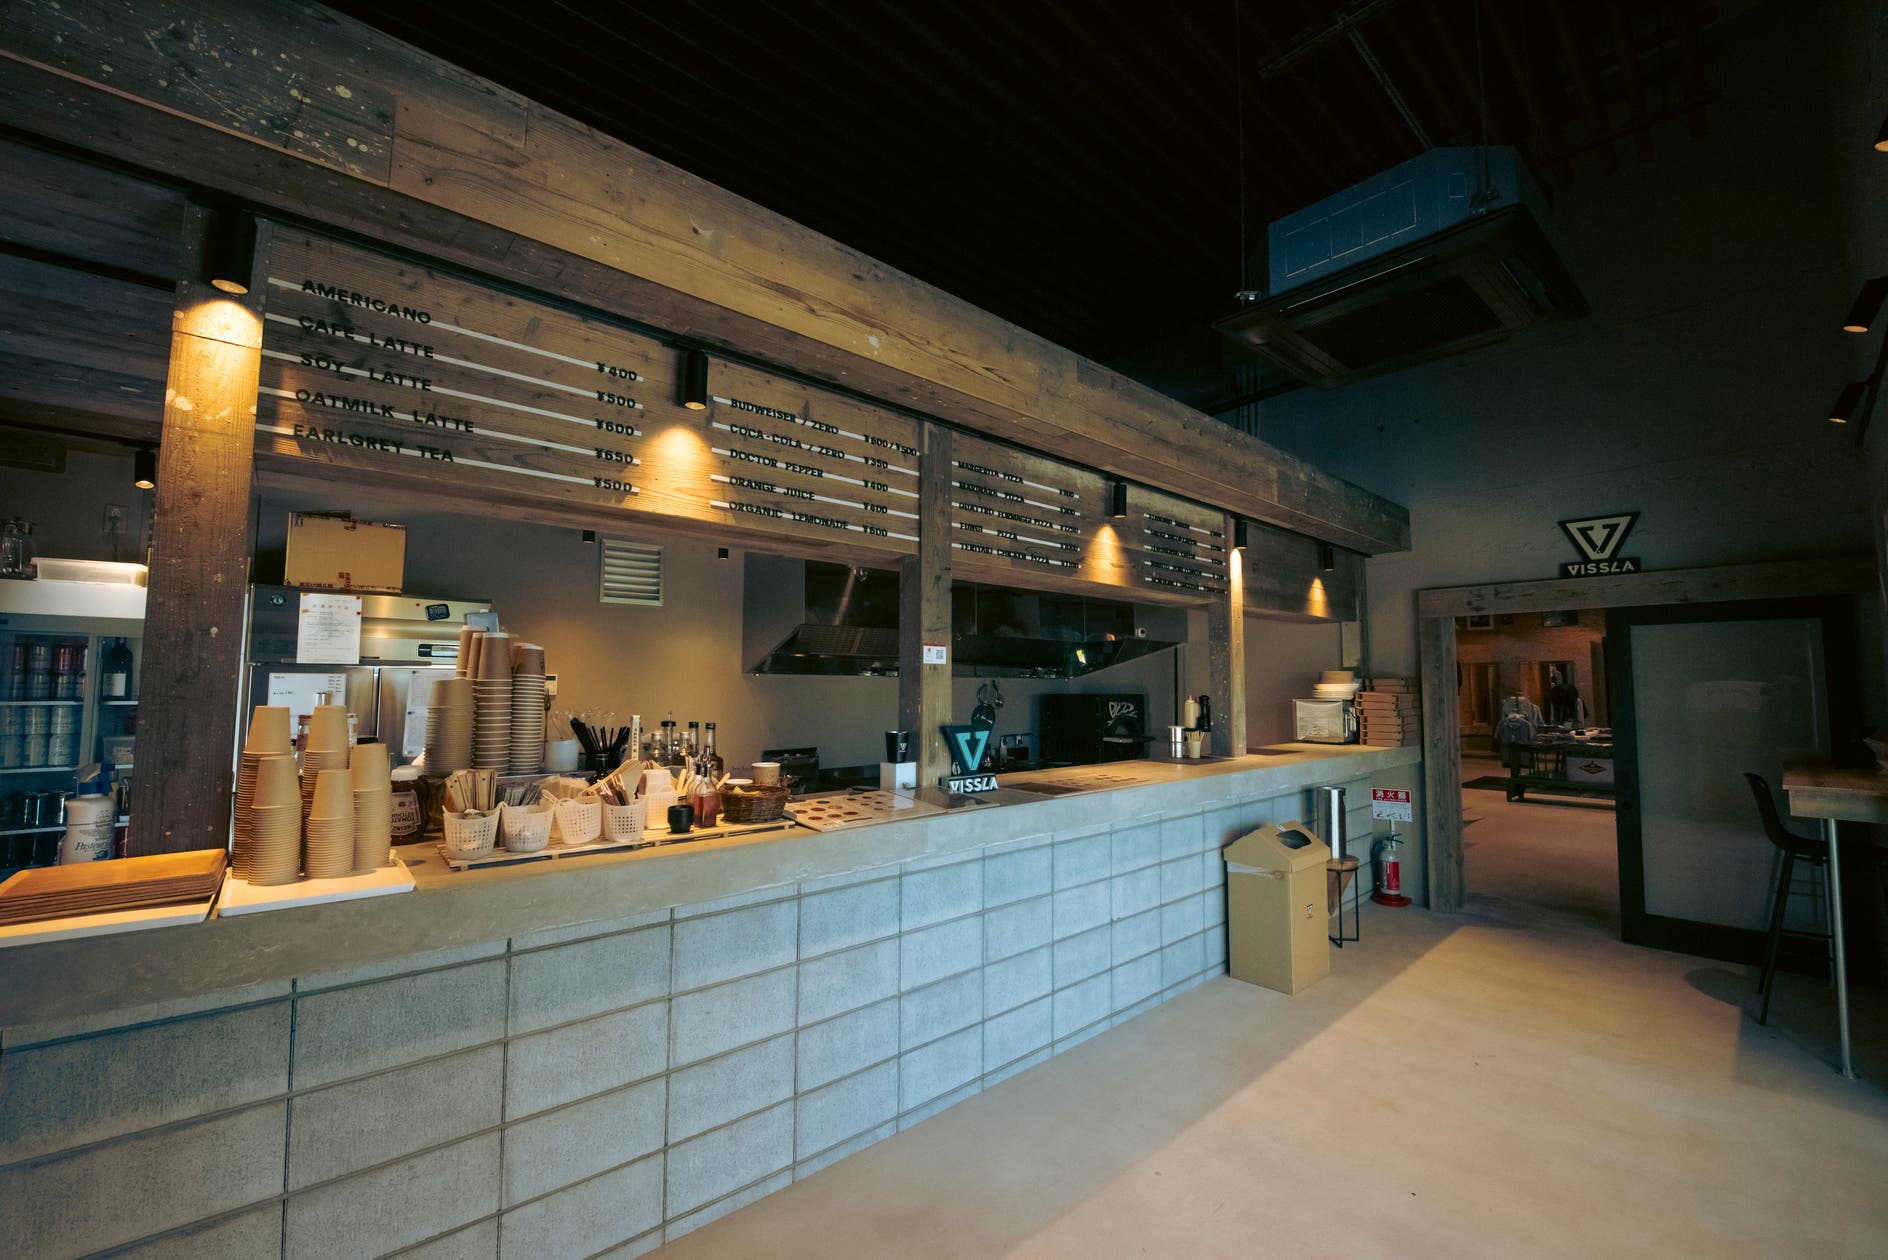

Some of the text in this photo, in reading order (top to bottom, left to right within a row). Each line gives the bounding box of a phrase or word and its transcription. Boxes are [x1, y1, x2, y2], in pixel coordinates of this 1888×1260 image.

[302, 280, 431, 324] AMERICANO
[299, 316, 434, 359] CAFE LATTE
[301, 353, 432, 391] SOY LATTE
[597, 362, 637, 381] ¥400
[597, 391, 635, 408] ¥500
[296, 389, 474, 433] OATMILK LATTE
[730, 398, 796, 423] BUDWEISER
[811, 420, 839, 435] ZERO
[596, 418, 634, 436] ¥600
[293, 424, 454, 462] EARLGREY TEA
[818, 445, 845, 459] ZERO
[595, 448, 633, 464] ¥650
[729, 448, 823, 478] DOCTOR PEPPER
[594, 477, 632, 493] ¥500
[730, 476, 815, 501] ORANGE JUICE
[864, 480, 888, 492] ¥400
[729, 501, 849, 530] ORGANIC LEMONADE
[864, 502, 887, 514] ¥400
[997, 530, 1018, 541] PIZZA
[1567, 560, 1636, 577] VISSLA
[948, 776, 998, 794] VISSLA
[1376, 789, 1406, 800] 消火器
